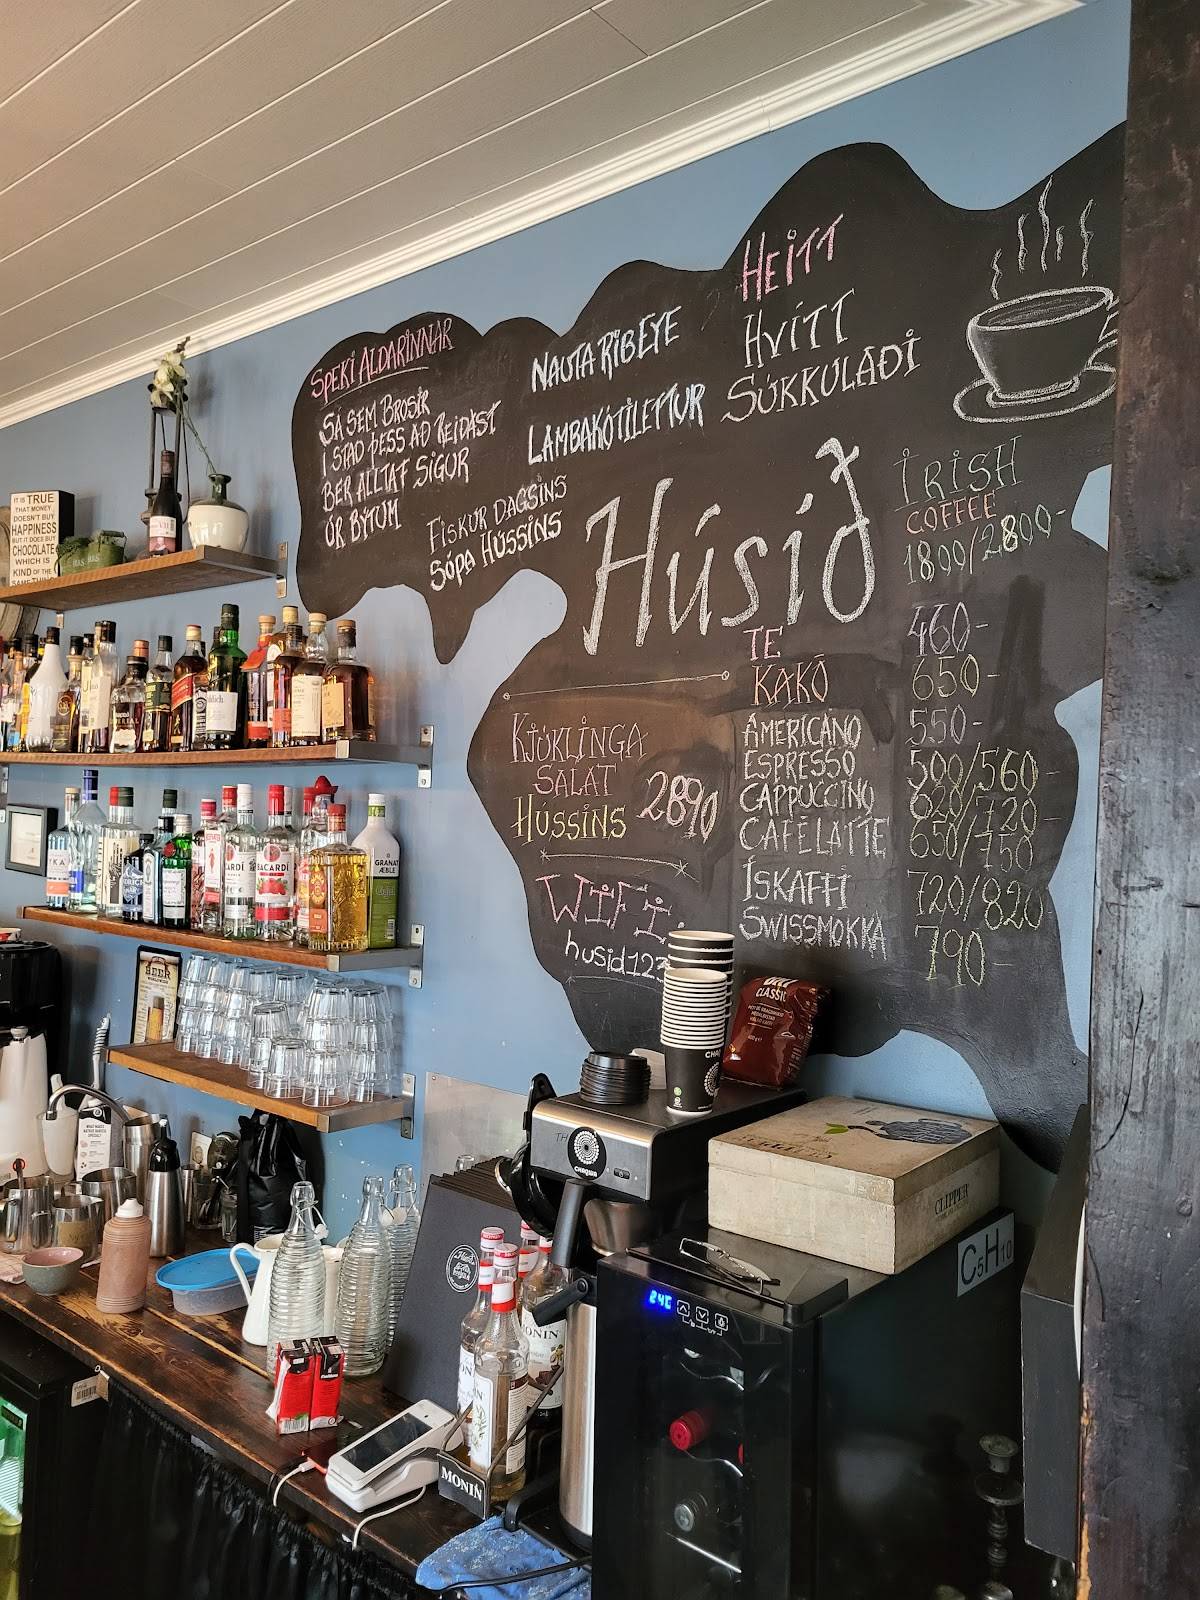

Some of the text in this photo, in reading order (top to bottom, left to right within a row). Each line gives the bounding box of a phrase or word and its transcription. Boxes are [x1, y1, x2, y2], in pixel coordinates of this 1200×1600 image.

[740, 213, 844, 302] HEITT
[310, 317, 456, 404] SPEKI ALDARINNAR
[530, 341, 597, 393] NAUTA
[346, 400, 377, 437] SEM
[380, 386, 431, 427] BROSIR
[321, 446, 470, 513] BER ALLTAF SIGUR
[894, 435, 1024, 512] IRISH
[13, 514, 40, 522] DOESN'T
[27, 493, 55, 505] TRUE
[493, 474, 568, 526] DAGSINS
[906, 490, 998, 534] COFFEE
[11, 522, 57, 536] HAPPINESS
[12, 543, 55, 557] CHOCOLATE
[13, 568, 32, 577] KIND
[743, 624, 784, 662] TE
[742, 708, 862, 749] AMERICANO
[532, 763, 617, 799] SALAT
[743, 748, 857, 784] ESPRESSO
[636, 770, 719, 844] 2890
[739, 777, 875, 819] CAPPUCCINO
[738, 905, 887, 961] SWISSMOKKA
[145, 965, 171, 980] BEER
[935, 1183, 969, 1215] CLIPPER
[525, 1326, 559, 1340] ONIN
[440, 1466, 483, 1501] MONIN
